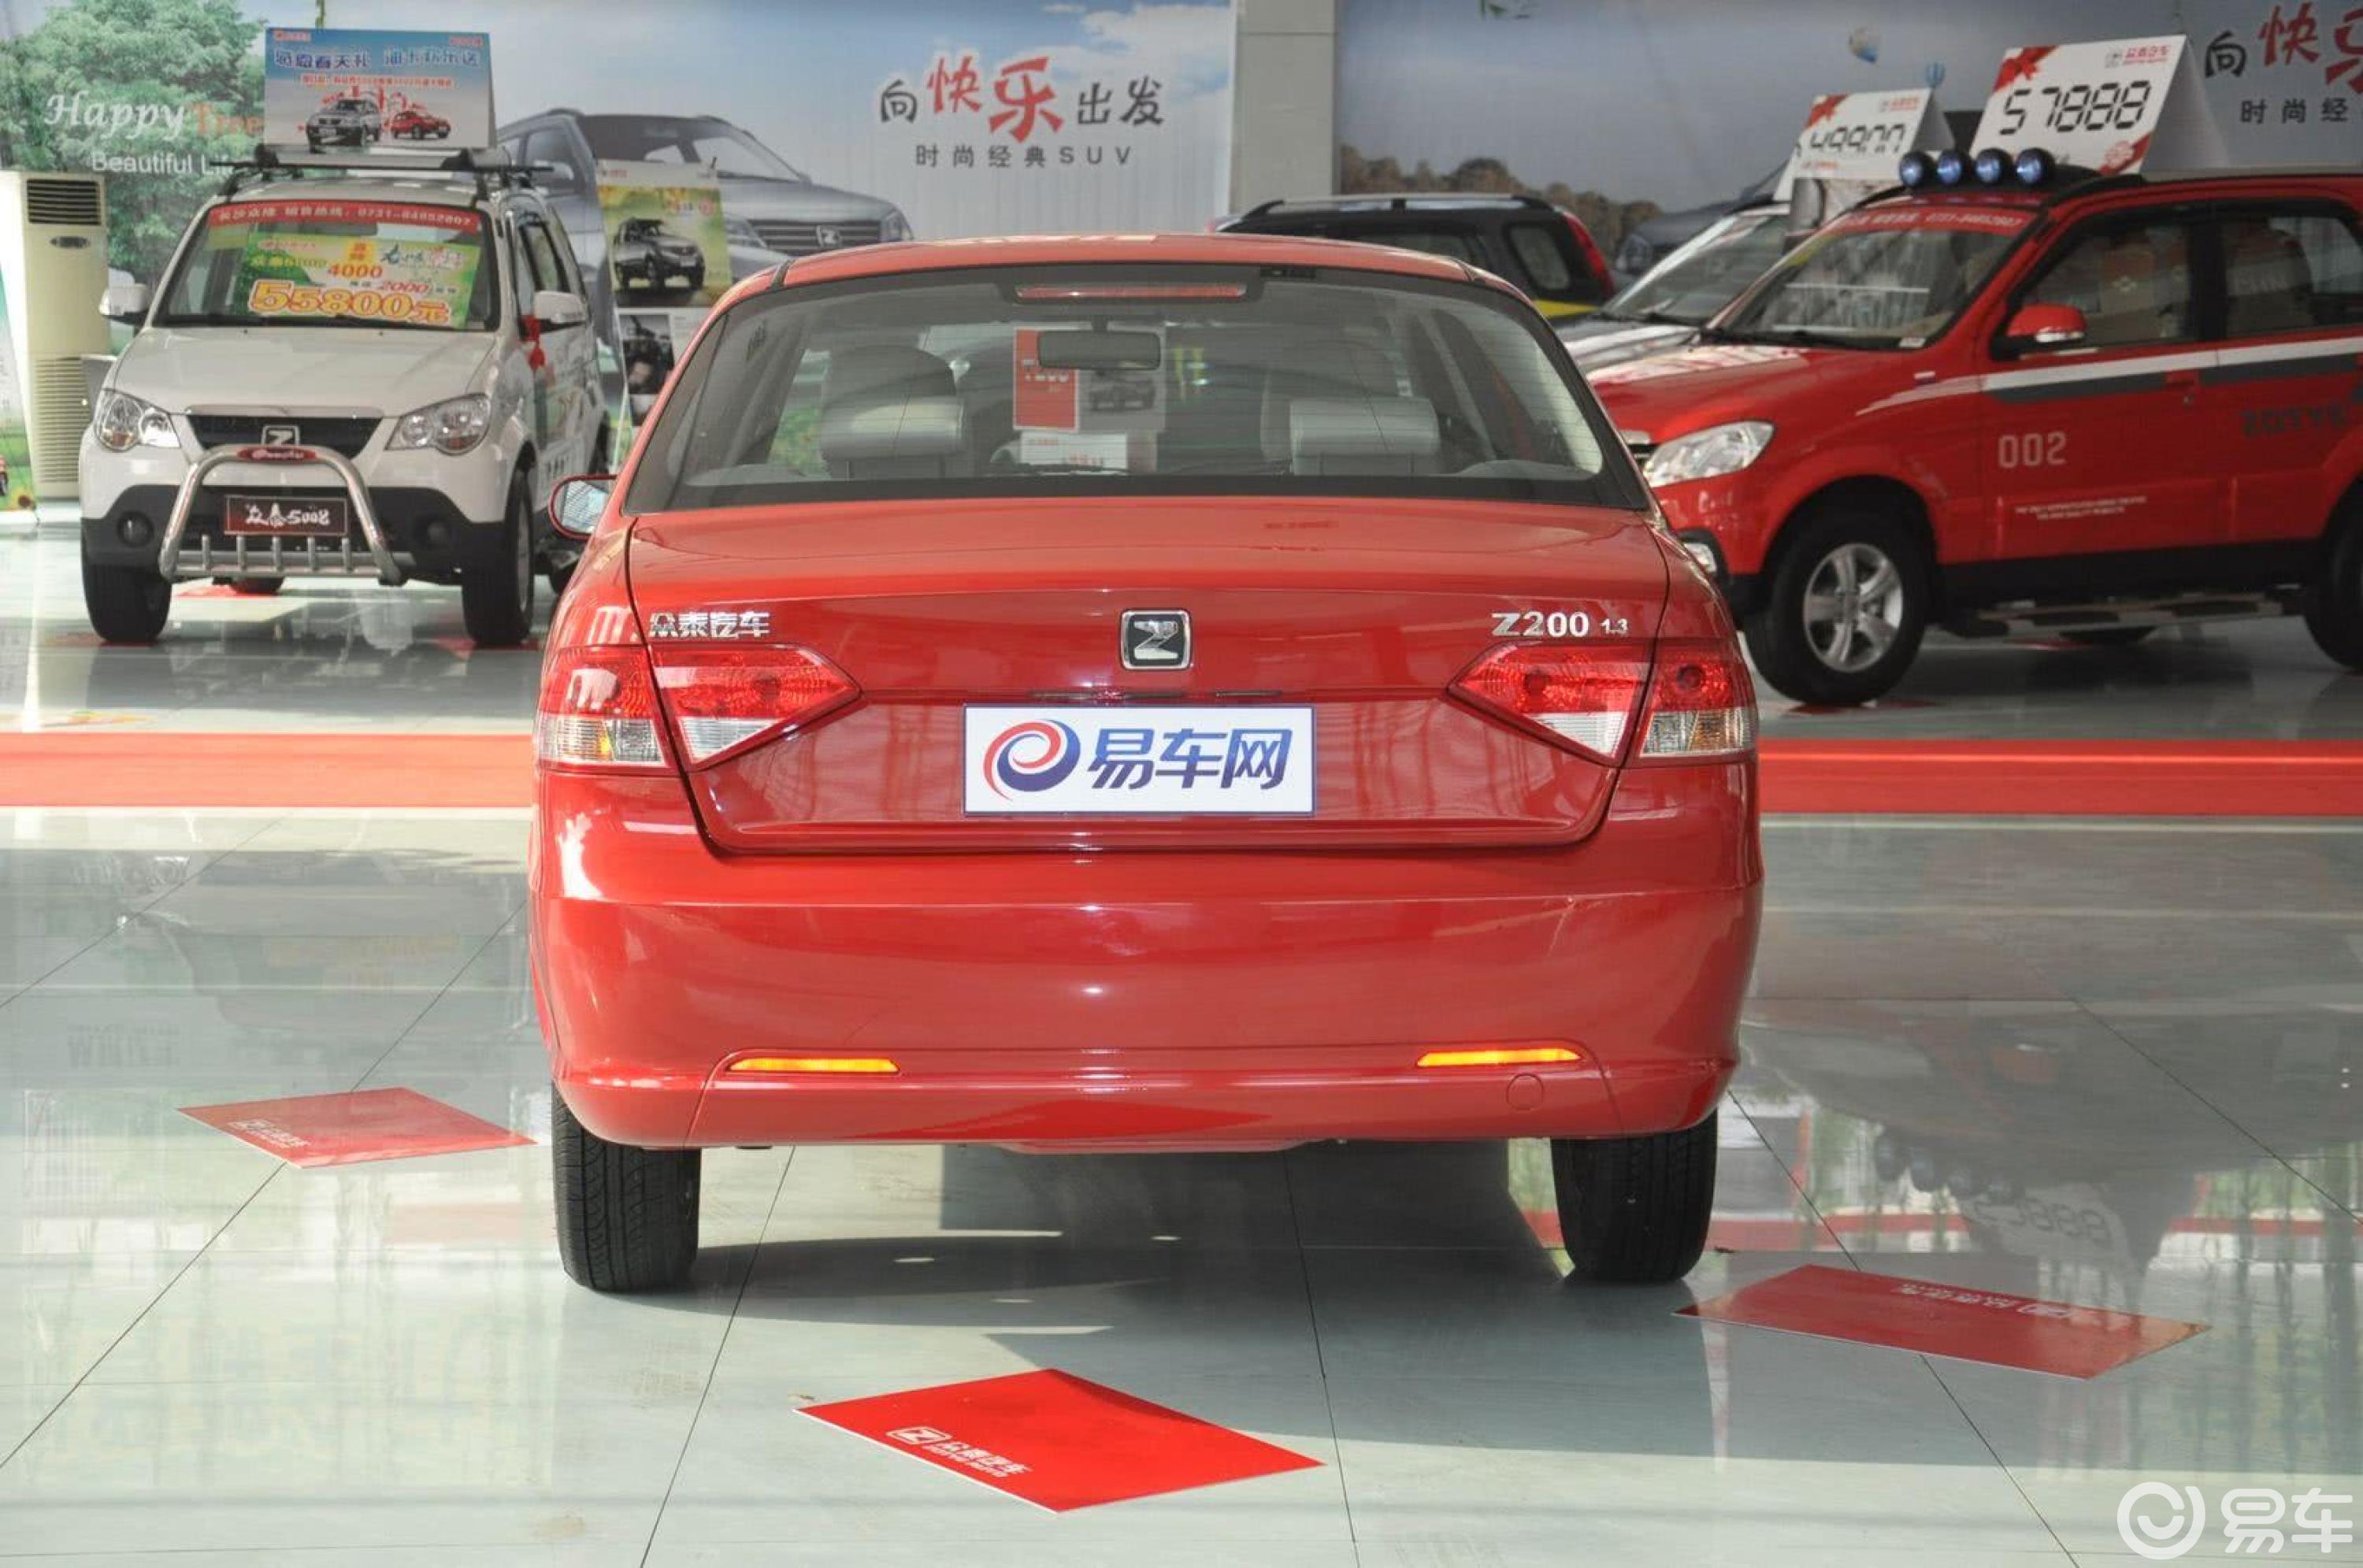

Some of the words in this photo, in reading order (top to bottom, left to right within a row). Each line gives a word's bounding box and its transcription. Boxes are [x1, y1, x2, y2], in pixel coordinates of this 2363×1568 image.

[44, 91, 185, 140] Happy
[880, 55, 1163, 143] 向快乐出发
[1999, 80, 2150, 135] 57888
[91, 150, 192, 174] Beautiful
[915, 143, 1131, 169] 时尚经典SUV
[249, 280, 451, 324] 55800元
[1999, 432, 2066, 468] 002
[649, 611, 770, 639] 众泰汽车
[1491, 611, 1590, 638] Z200
[1087, 728, 1293, 790] 易车网
